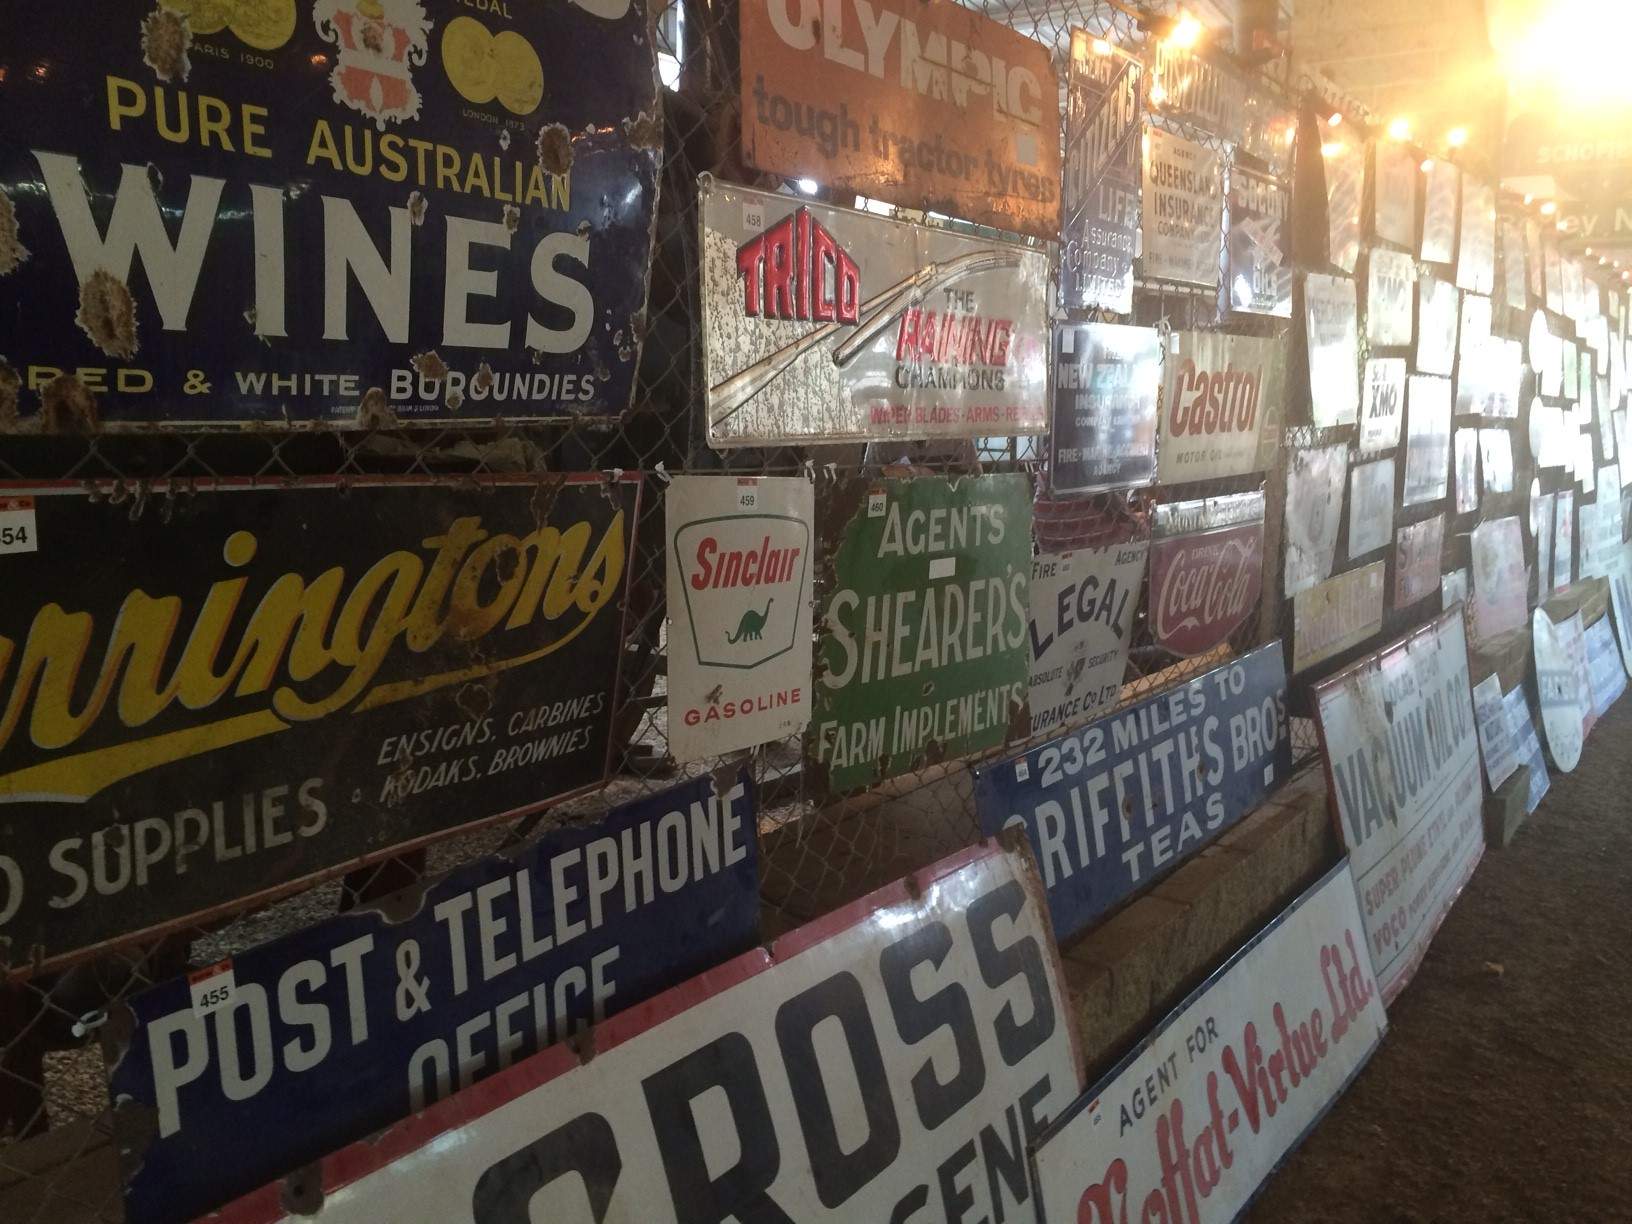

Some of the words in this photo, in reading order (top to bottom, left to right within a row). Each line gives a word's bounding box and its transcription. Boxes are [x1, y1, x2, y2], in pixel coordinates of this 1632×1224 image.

[193, 43, 230, 60] ARIS
[239, 53, 274, 71] 1900
[106, 75, 275, 158] PURE
[306, 119, 572, 212] AUSTRALIAN
[462, 110, 499, 125] LONDON
[753, 73, 861, 160] tough
[867, 111, 979, 180] tractor
[984, 147, 1055, 202] tyres
[745, 214, 762, 227] 458
[30, 150, 595, 354] WINES
[736, 205, 861, 326] TRICO
[943, 287, 976, 312] THE
[27, 364, 154, 394] RED
[182, 369, 213, 395] &
[233, 371, 360, 397] WHITE
[390, 369, 595, 402] BURGUNDIES
[895, 364, 1006, 392] CHAMPIONS
[1058, 362, 1094, 389] NEW
[1169, 358, 1264, 438] Castrol
[1175, 450, 1206, 465] MOTOR
[739, 495, 755, 508] 459
[869, 501, 884, 513] 460
[877, 502, 1006, 558] AGENTS
[691, 535, 801, 591] Sinclair
[1031, 561, 1057, 580] FIRE
[0, 510, 627, 750] rringtons
[822, 564, 1028, 690] SHEARER'S
[1028, 575, 1130, 662] LEGAL
[507, 692, 607, 737] CARBINES
[684, 688, 801, 727] GASOLINE
[817, 717, 886, 770] FARM
[891, 681, 1024, 756] IMPLEMENTS
[1038, 727, 1107, 789] 232
[1111, 682, 1207, 754] MILES
[1214, 665, 1247, 701] TO
[487, 725, 594, 777] BROWNIES
[1334, 704, 1431, 849] VACUUM
[1002, 714, 1226, 890] RIFFITHS
[48, 778, 328, 909] SUPPLIES
[1121, 791, 1226, 883] TEAS
[147, 933, 376, 1139] POST
[395, 938, 431, 1023] &
[433, 784, 749, 997] TELEPHONE
[199, 984, 231, 1011] 455
[1119, 1051, 1180, 1138] AGENT
[1185, 1016, 1220, 1064] FOR
